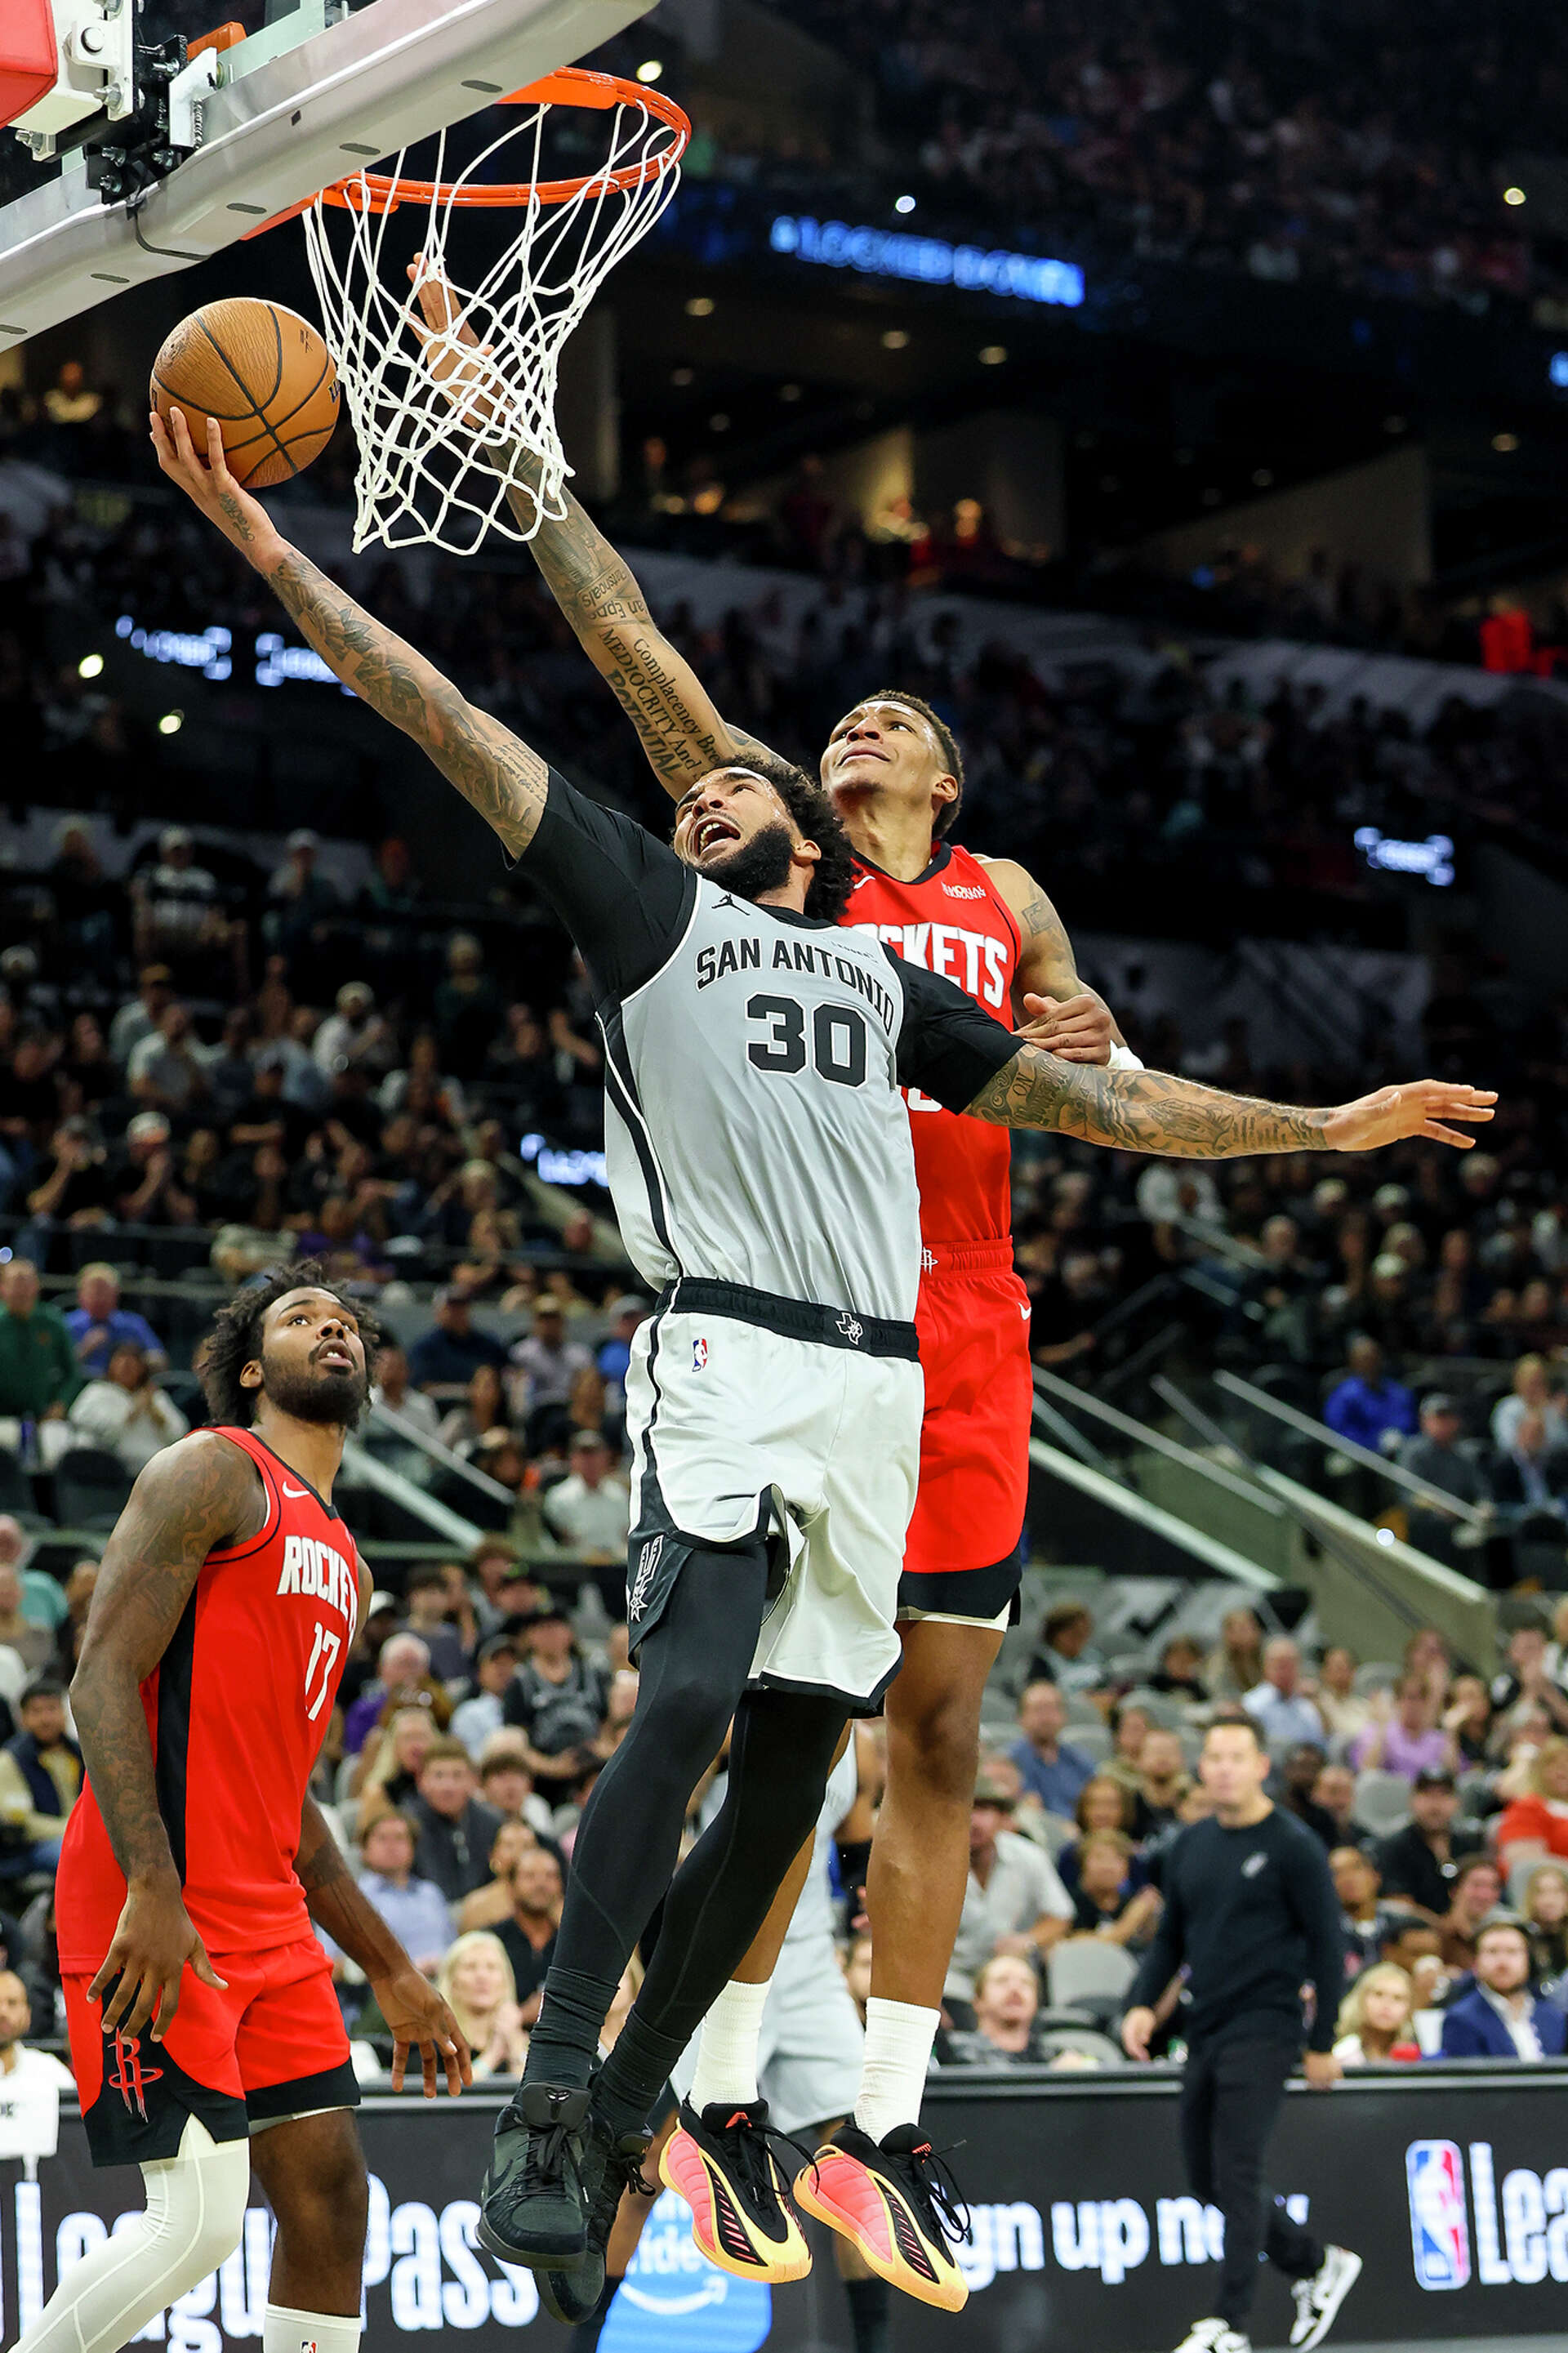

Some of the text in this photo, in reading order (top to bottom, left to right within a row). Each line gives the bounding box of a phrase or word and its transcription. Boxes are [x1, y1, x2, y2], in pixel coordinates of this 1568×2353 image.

[598, 628, 682, 737] MEDIOCRITY
[672, 738, 702, 772] And
[633, 638, 721, 769] Complacency Bre
[696, 937, 895, 1037] SAN ANTONIO
[745, 991, 868, 1089] 30
[304, 1621, 341, 1722] 17
[1051, 2197, 1151, 2285] up
